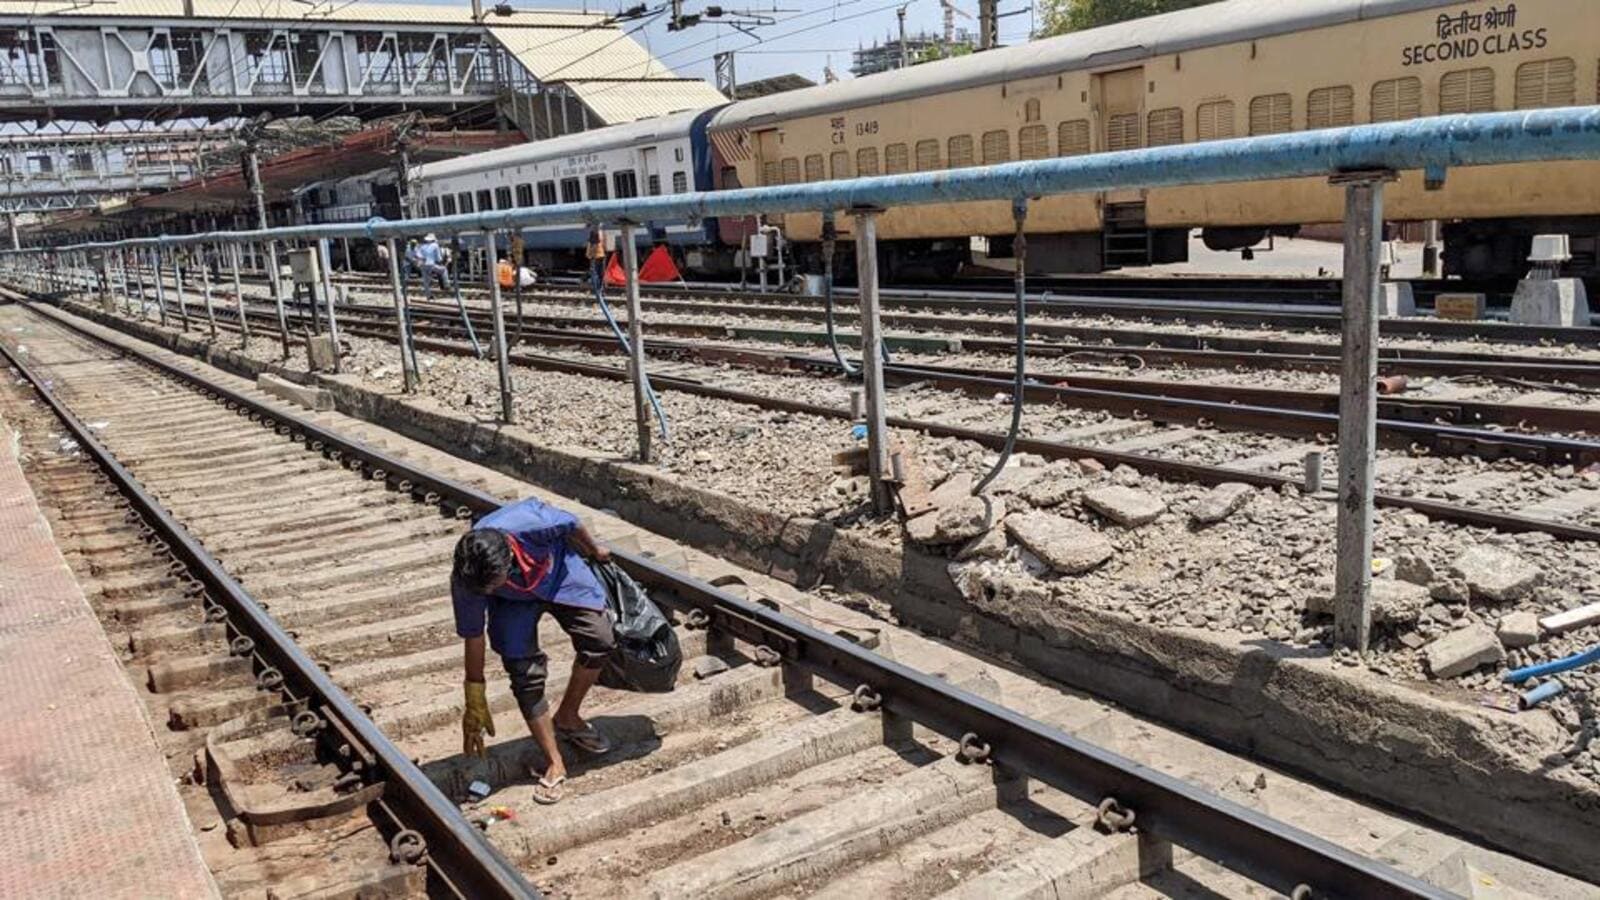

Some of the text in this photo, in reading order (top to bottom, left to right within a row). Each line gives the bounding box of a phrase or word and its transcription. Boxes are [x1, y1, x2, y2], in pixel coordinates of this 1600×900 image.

[1436, 4, 1516, 40] द्वितीय श्रेणी
[1402, 28, 1547, 66] SECOND CLASS
